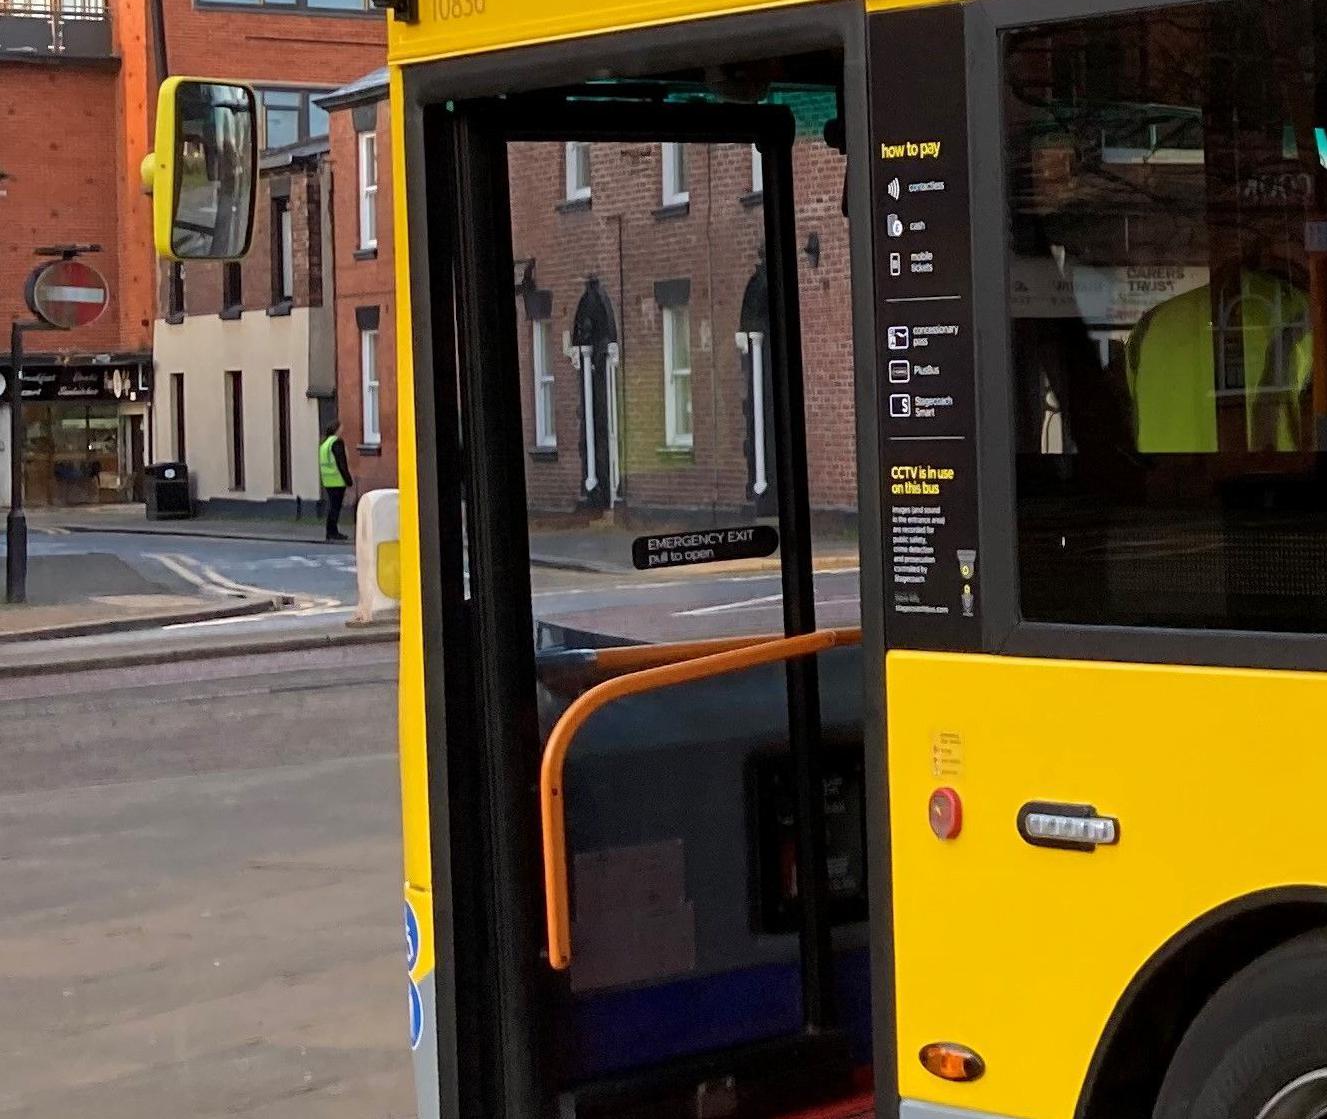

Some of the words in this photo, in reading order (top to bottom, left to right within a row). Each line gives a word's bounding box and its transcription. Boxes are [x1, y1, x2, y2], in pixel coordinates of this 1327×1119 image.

[881, 142, 904, 159] how
[906, 141, 918, 157] to
[919, 140, 941, 159] pay
[912, 324, 959, 336] concessionary
[914, 406, 935, 418] Smart
[891, 466, 917, 480] CCTV
[918, 465, 926, 480] is
[927, 465, 936, 480] in
[937, 468, 955, 480] use
[891, 483, 903, 495] on
[904, 481, 922, 495] this
[922, 481, 940, 495] bus
[648, 532, 725, 551] EMERGENCY
[727, 529, 755, 543] EXIT
[648, 550, 668, 567] pull
[670, 550, 683, 562] to
[684, 548, 715, 564] open
